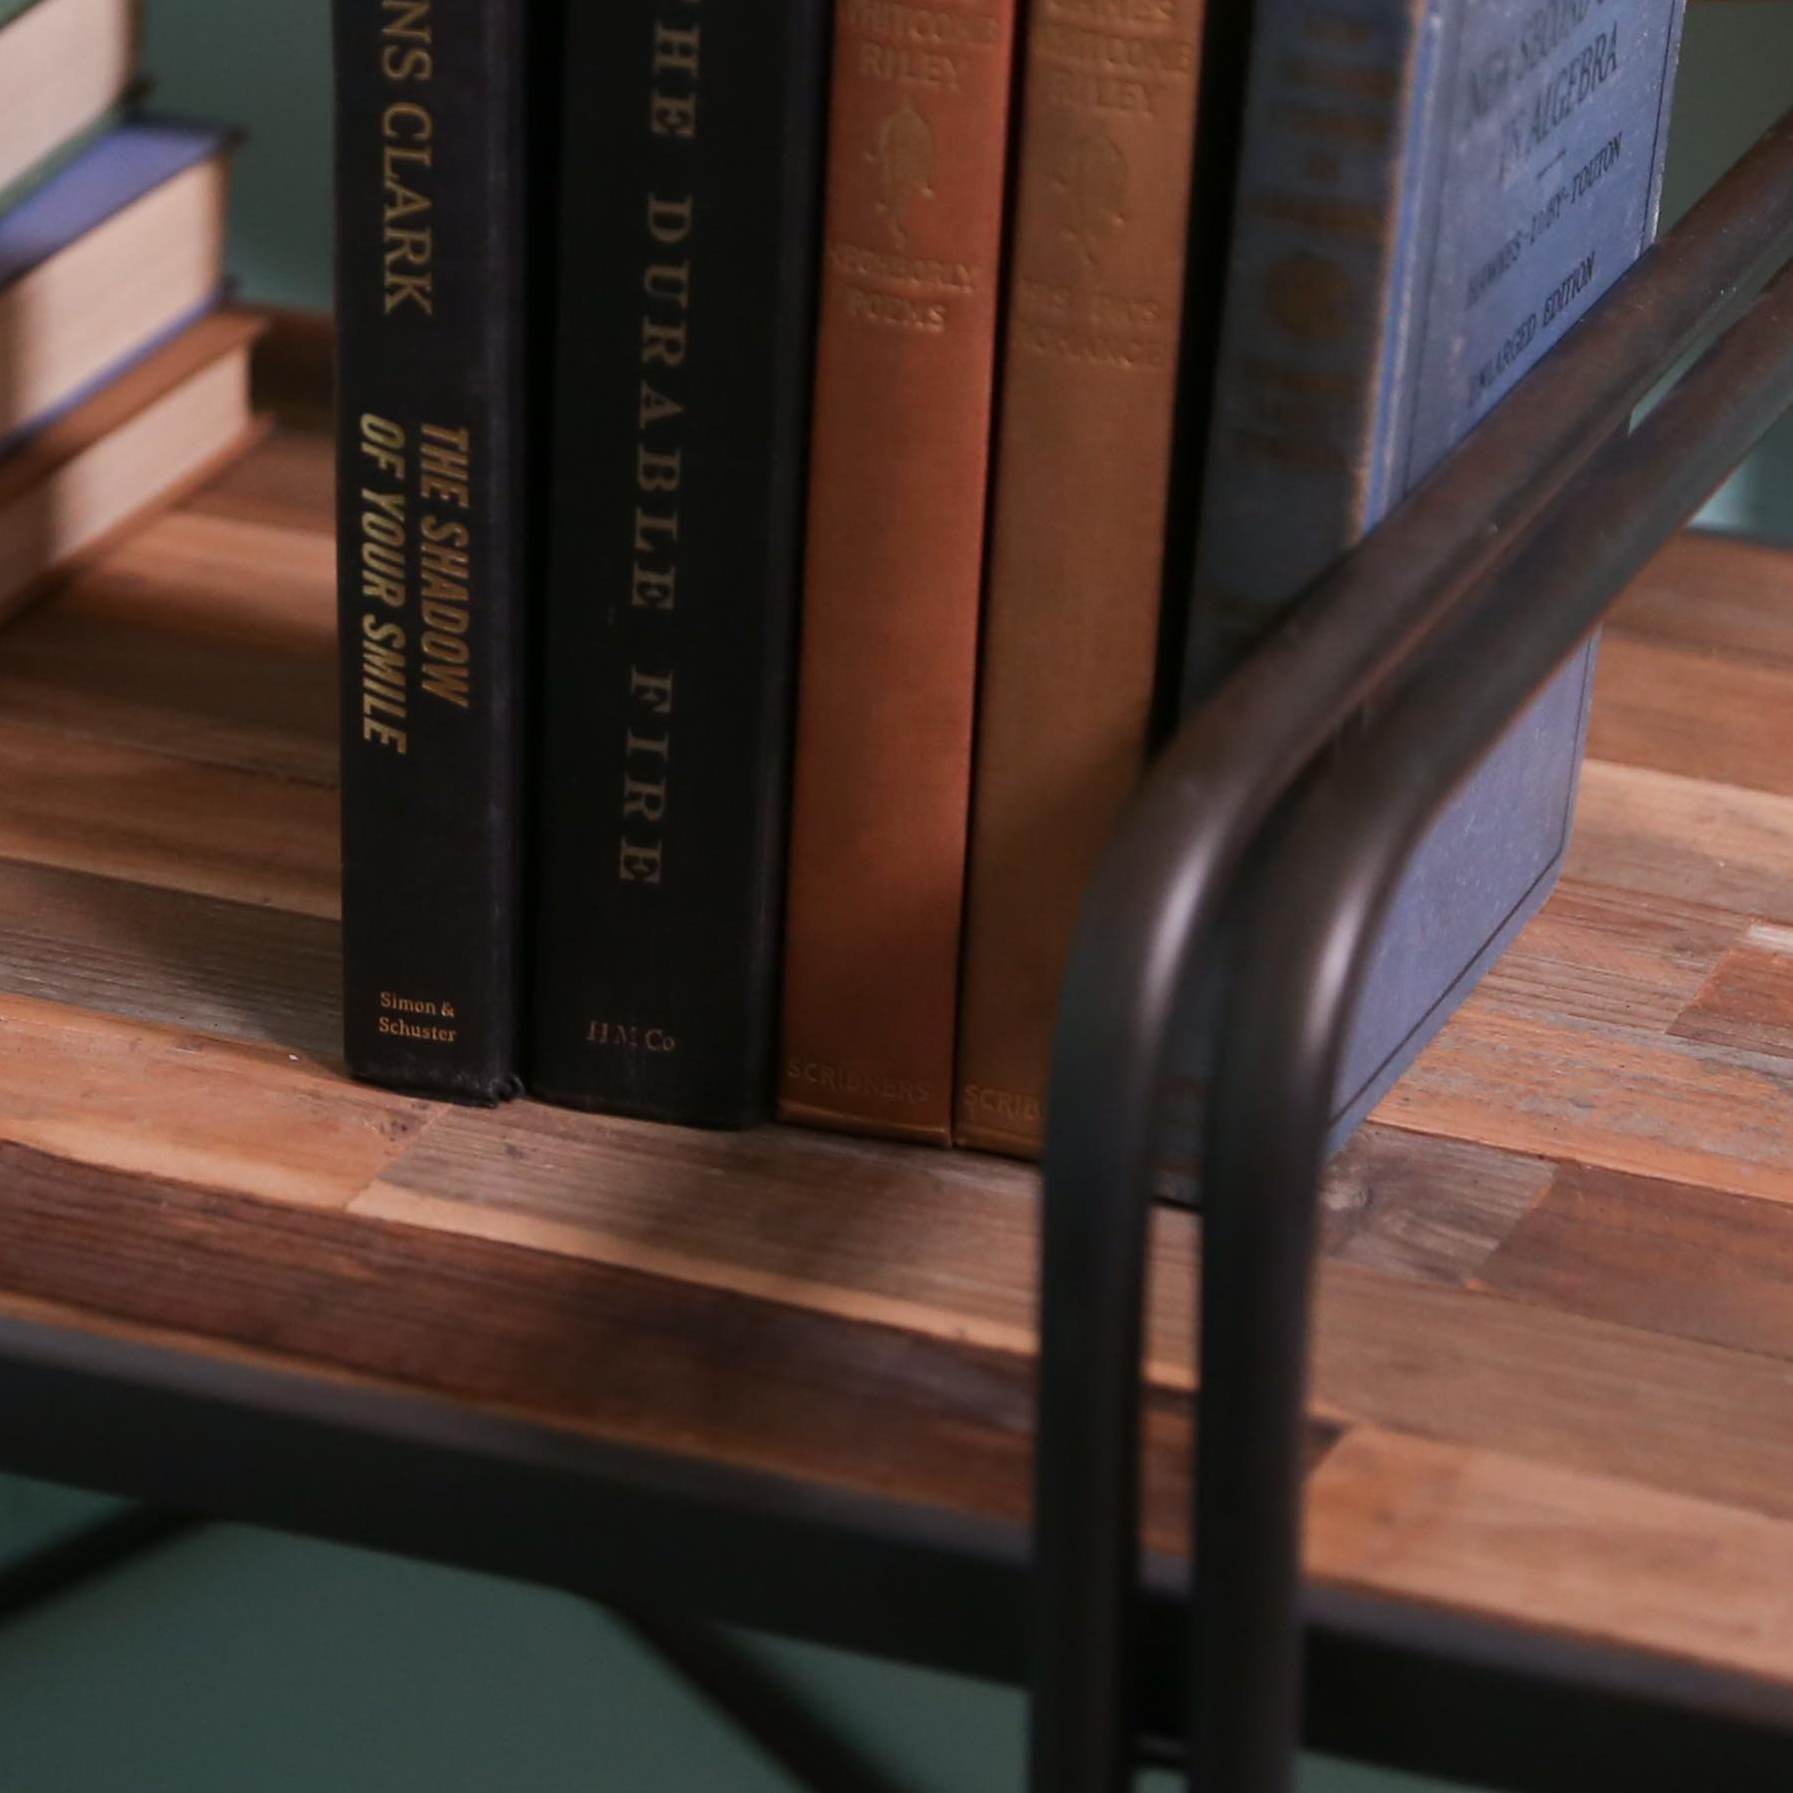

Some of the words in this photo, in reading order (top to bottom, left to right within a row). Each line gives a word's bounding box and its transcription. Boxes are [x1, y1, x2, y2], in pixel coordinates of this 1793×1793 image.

[858, 40, 971, 92] RILEY
[1530, 20, 1618, 146] ALGEBRA
[382, 101, 434, 316] CLARK
[1542, 250, 1596, 329] EDITION
[359, 412, 406, 482] OF
[630, 192, 694, 611] DURABLE
[419, 421, 470, 509] THE
[360, 486, 406, 608] YOUR
[419, 513, 470, 708] SHADOW
[361, 612, 407, 755] SMILE
[618, 664, 674, 886] FIRE
[378, 1016, 458, 1044] Schuster
[379, 990, 436, 1017] Simon
[440, 1000, 456, 1019] &
[787, 1058, 931, 1103] SCRIBNERS
